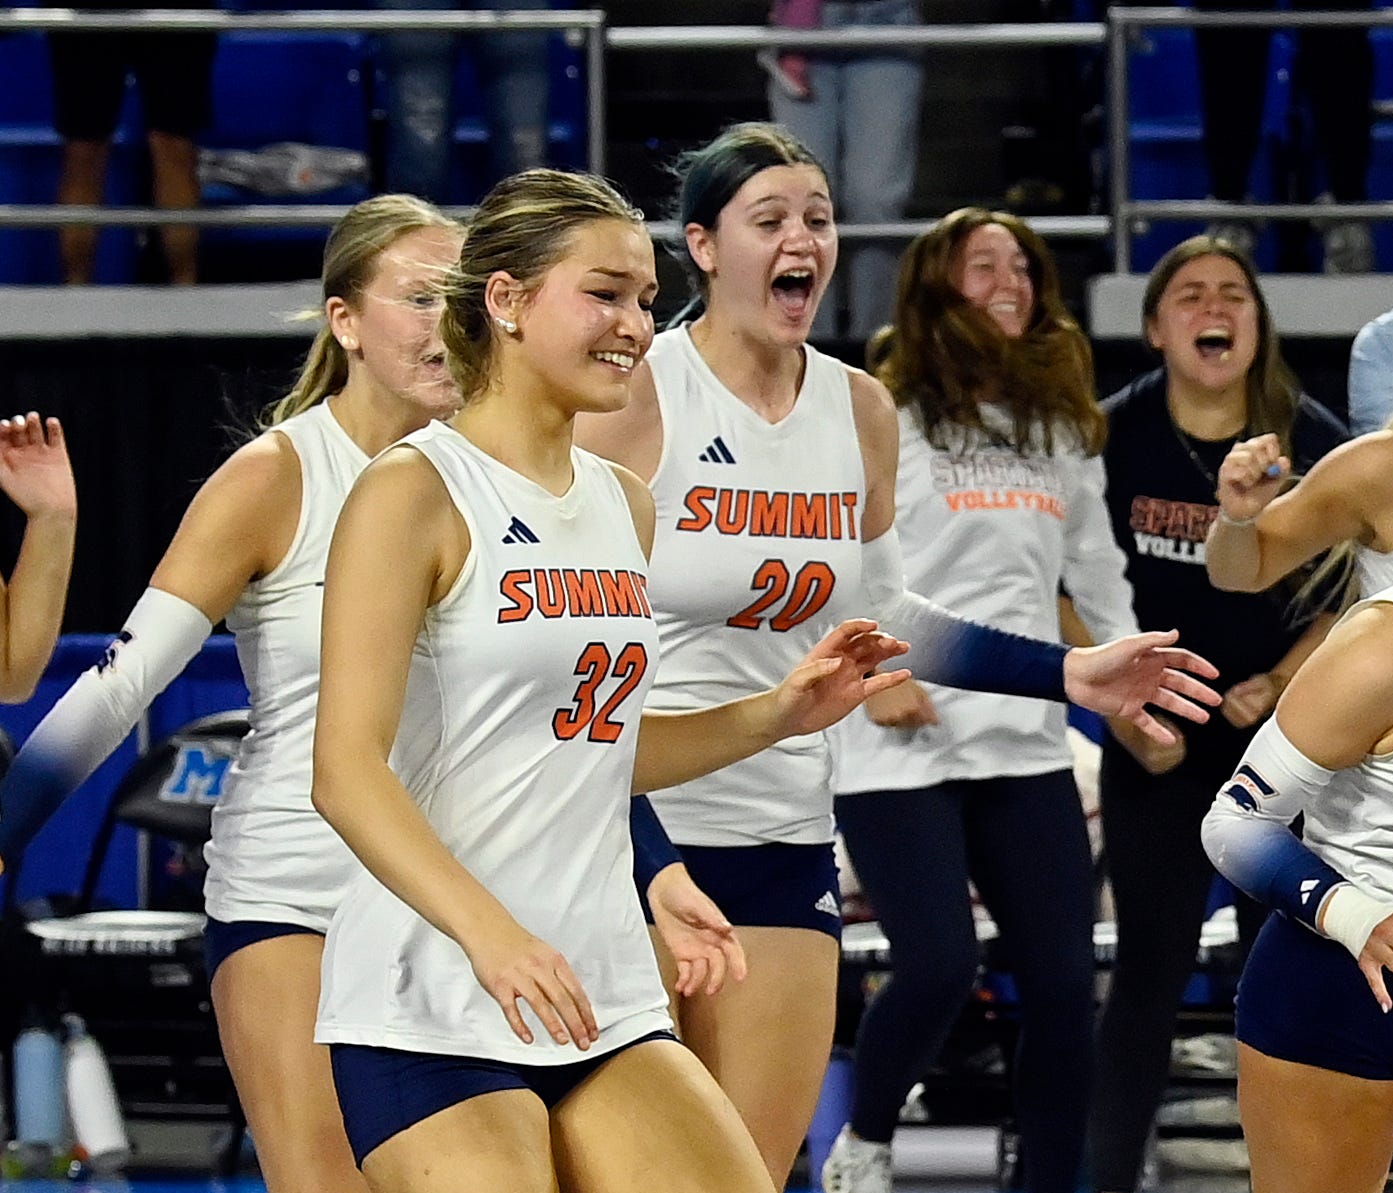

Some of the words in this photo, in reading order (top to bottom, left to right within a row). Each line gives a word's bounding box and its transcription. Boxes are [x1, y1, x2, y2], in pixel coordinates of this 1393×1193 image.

[676, 485, 857, 540] SUMMIT
[726, 559, 836, 632] 20
[552, 642, 648, 744] 32
